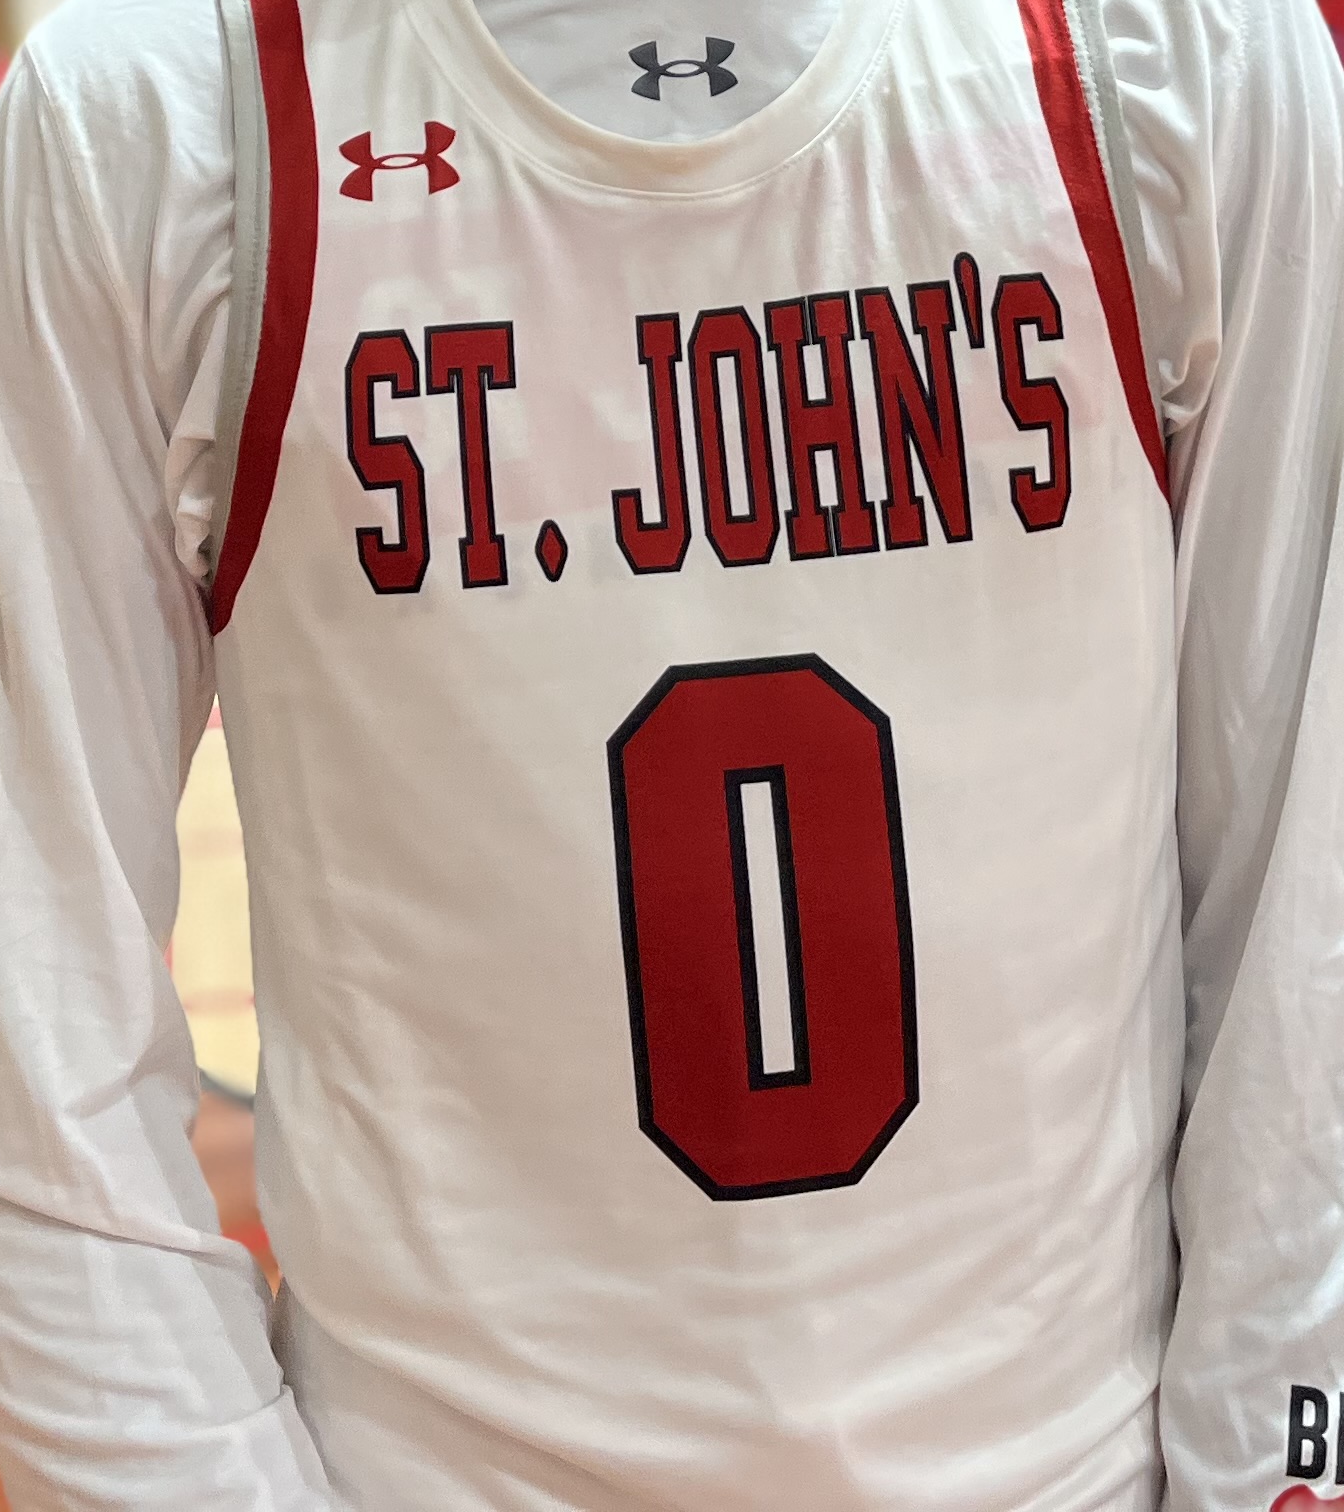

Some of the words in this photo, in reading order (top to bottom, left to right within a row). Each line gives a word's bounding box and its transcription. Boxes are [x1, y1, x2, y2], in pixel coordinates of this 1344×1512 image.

[345, 320, 568, 595] ST.
[612, 252, 1073, 576] JOHN'S
[607, 653, 919, 1201] 0
